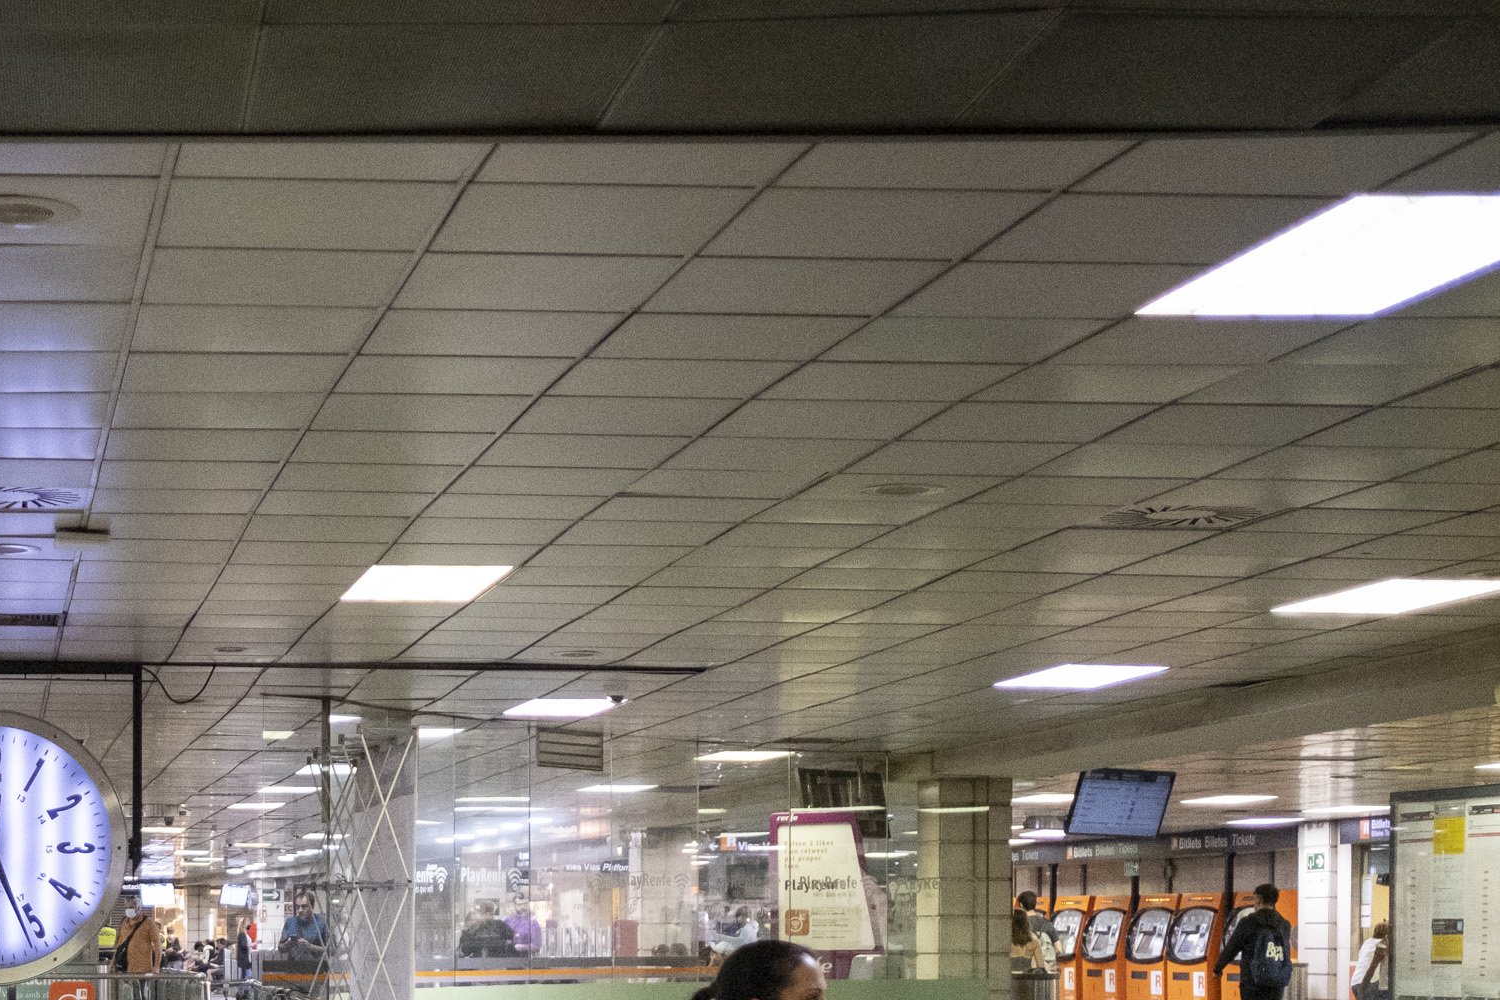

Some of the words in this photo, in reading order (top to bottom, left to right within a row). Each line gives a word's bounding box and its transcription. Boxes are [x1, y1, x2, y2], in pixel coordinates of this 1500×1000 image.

[23, 757, 46, 793] 1
[16, 793, 27, 804] 13
[46, 793, 83, 821] 2
[36, 814, 47, 825] 14
[776, 813, 799, 823] renfe
[45, 844, 53, 854] 15
[56, 841, 96, 855] 3
[36, 872, 47, 882] 16
[48, 877, 83, 901] 4
[15, 893, 26, 903] 17
[21, 902, 46, 939] 5
